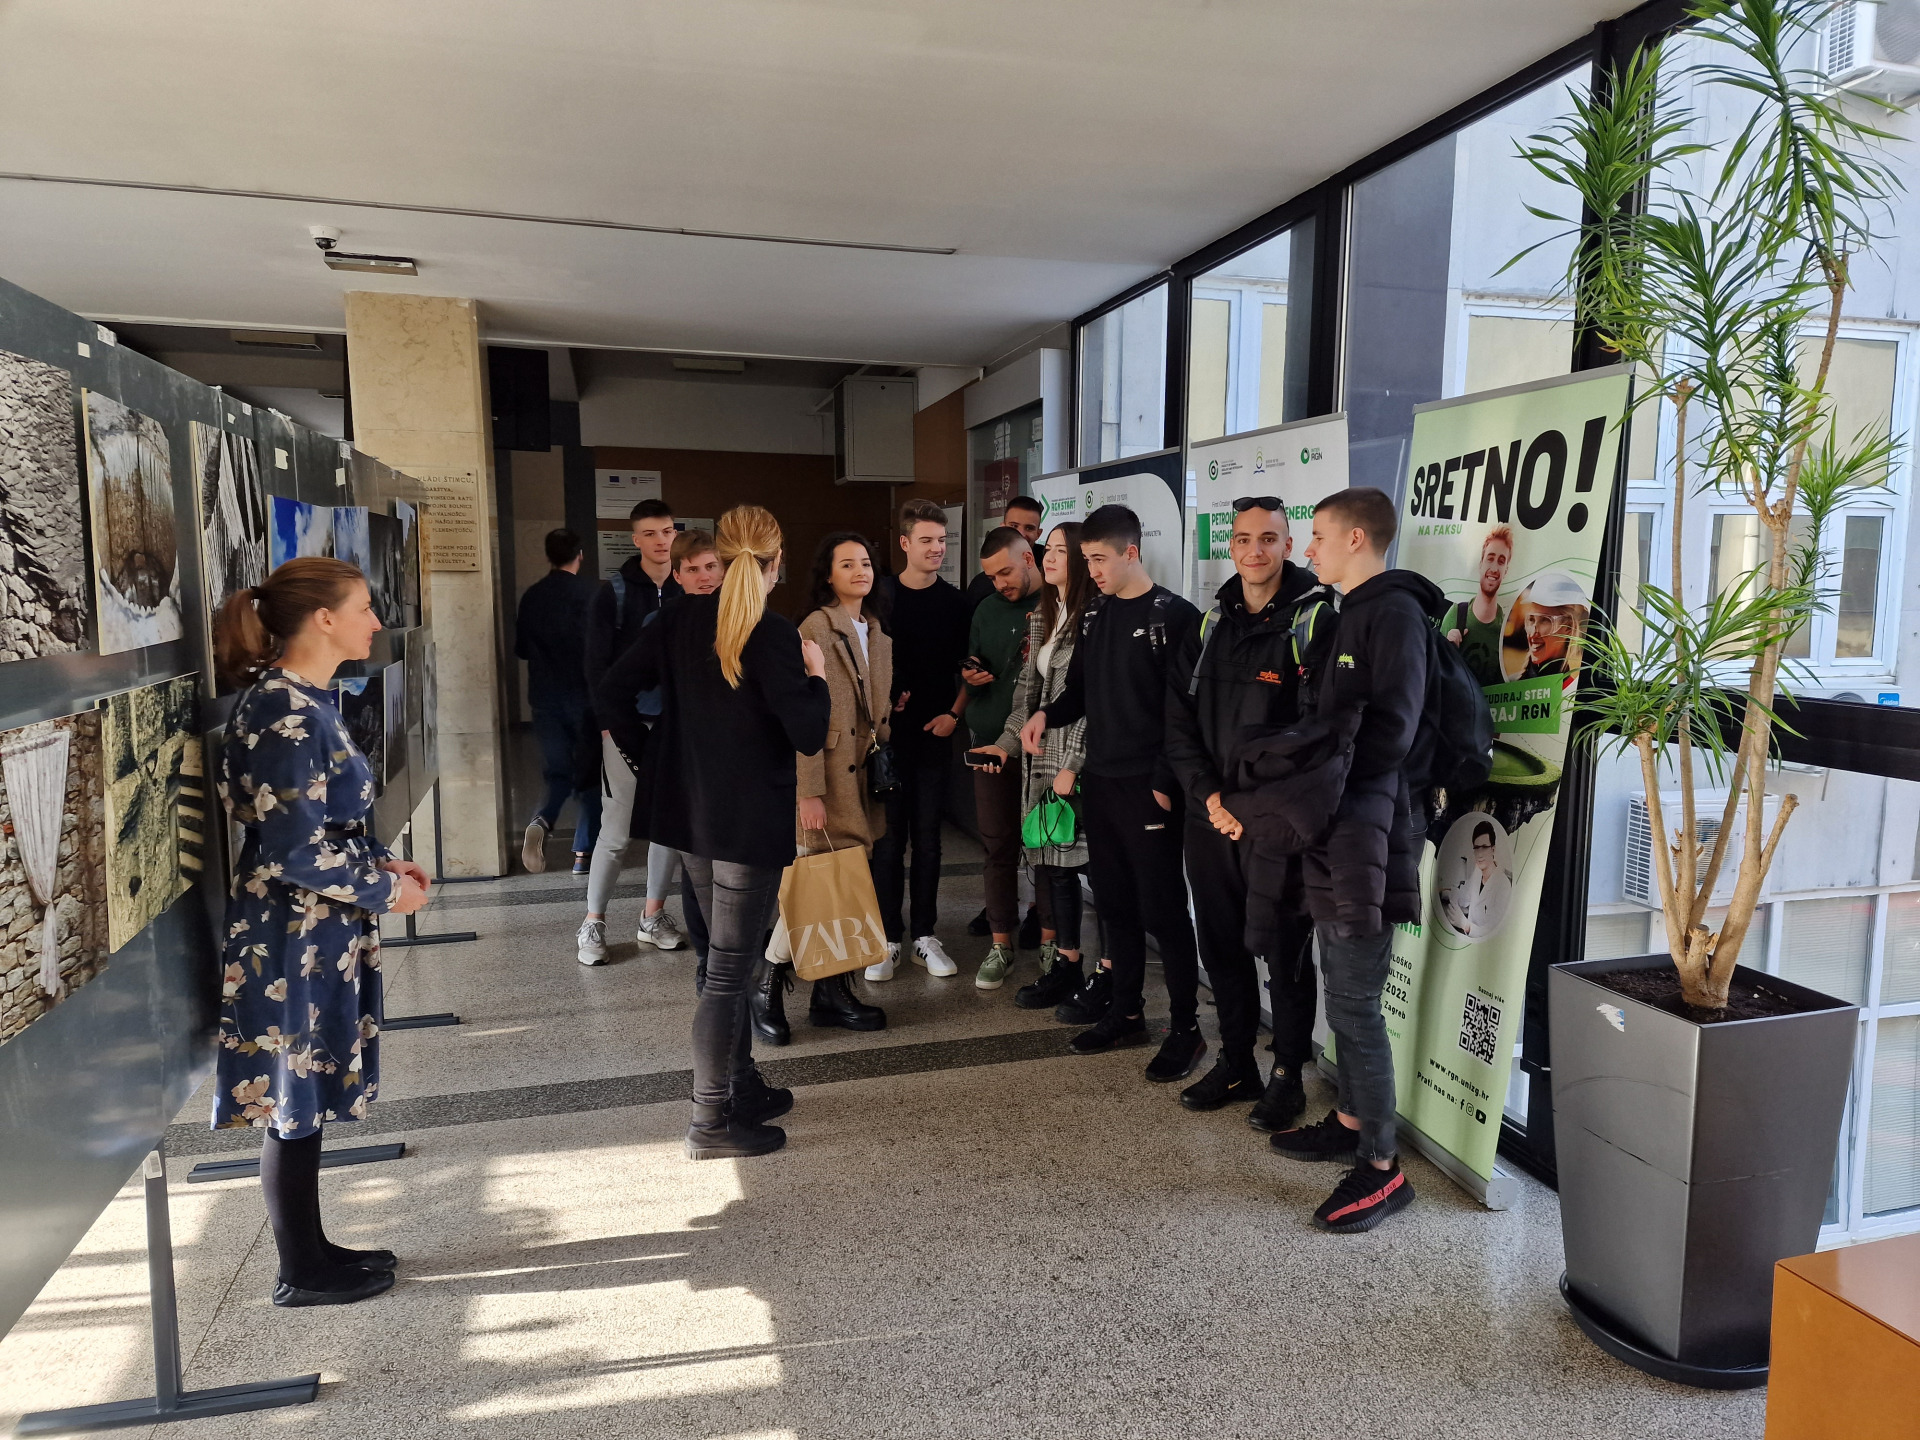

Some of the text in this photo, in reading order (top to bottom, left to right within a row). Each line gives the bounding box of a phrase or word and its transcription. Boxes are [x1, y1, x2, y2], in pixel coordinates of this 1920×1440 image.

[1410, 415, 1607, 533] SRETNO!
[1418, 523, 1463, 536] NA FAKSU
[1524, 687, 1551, 701] STEM
[1520, 702, 1551, 720] RGN
[788, 911, 888, 971] ZARA
[1384, 1000, 1406, 1020] Zagreb
[1416, 1071, 1433, 1088] Prati
[1433, 1084, 1445, 1097] nas
[1446, 1091, 1458, 1105] na:
[1429, 1058, 1490, 1101] www.rgn.unizg.hr
